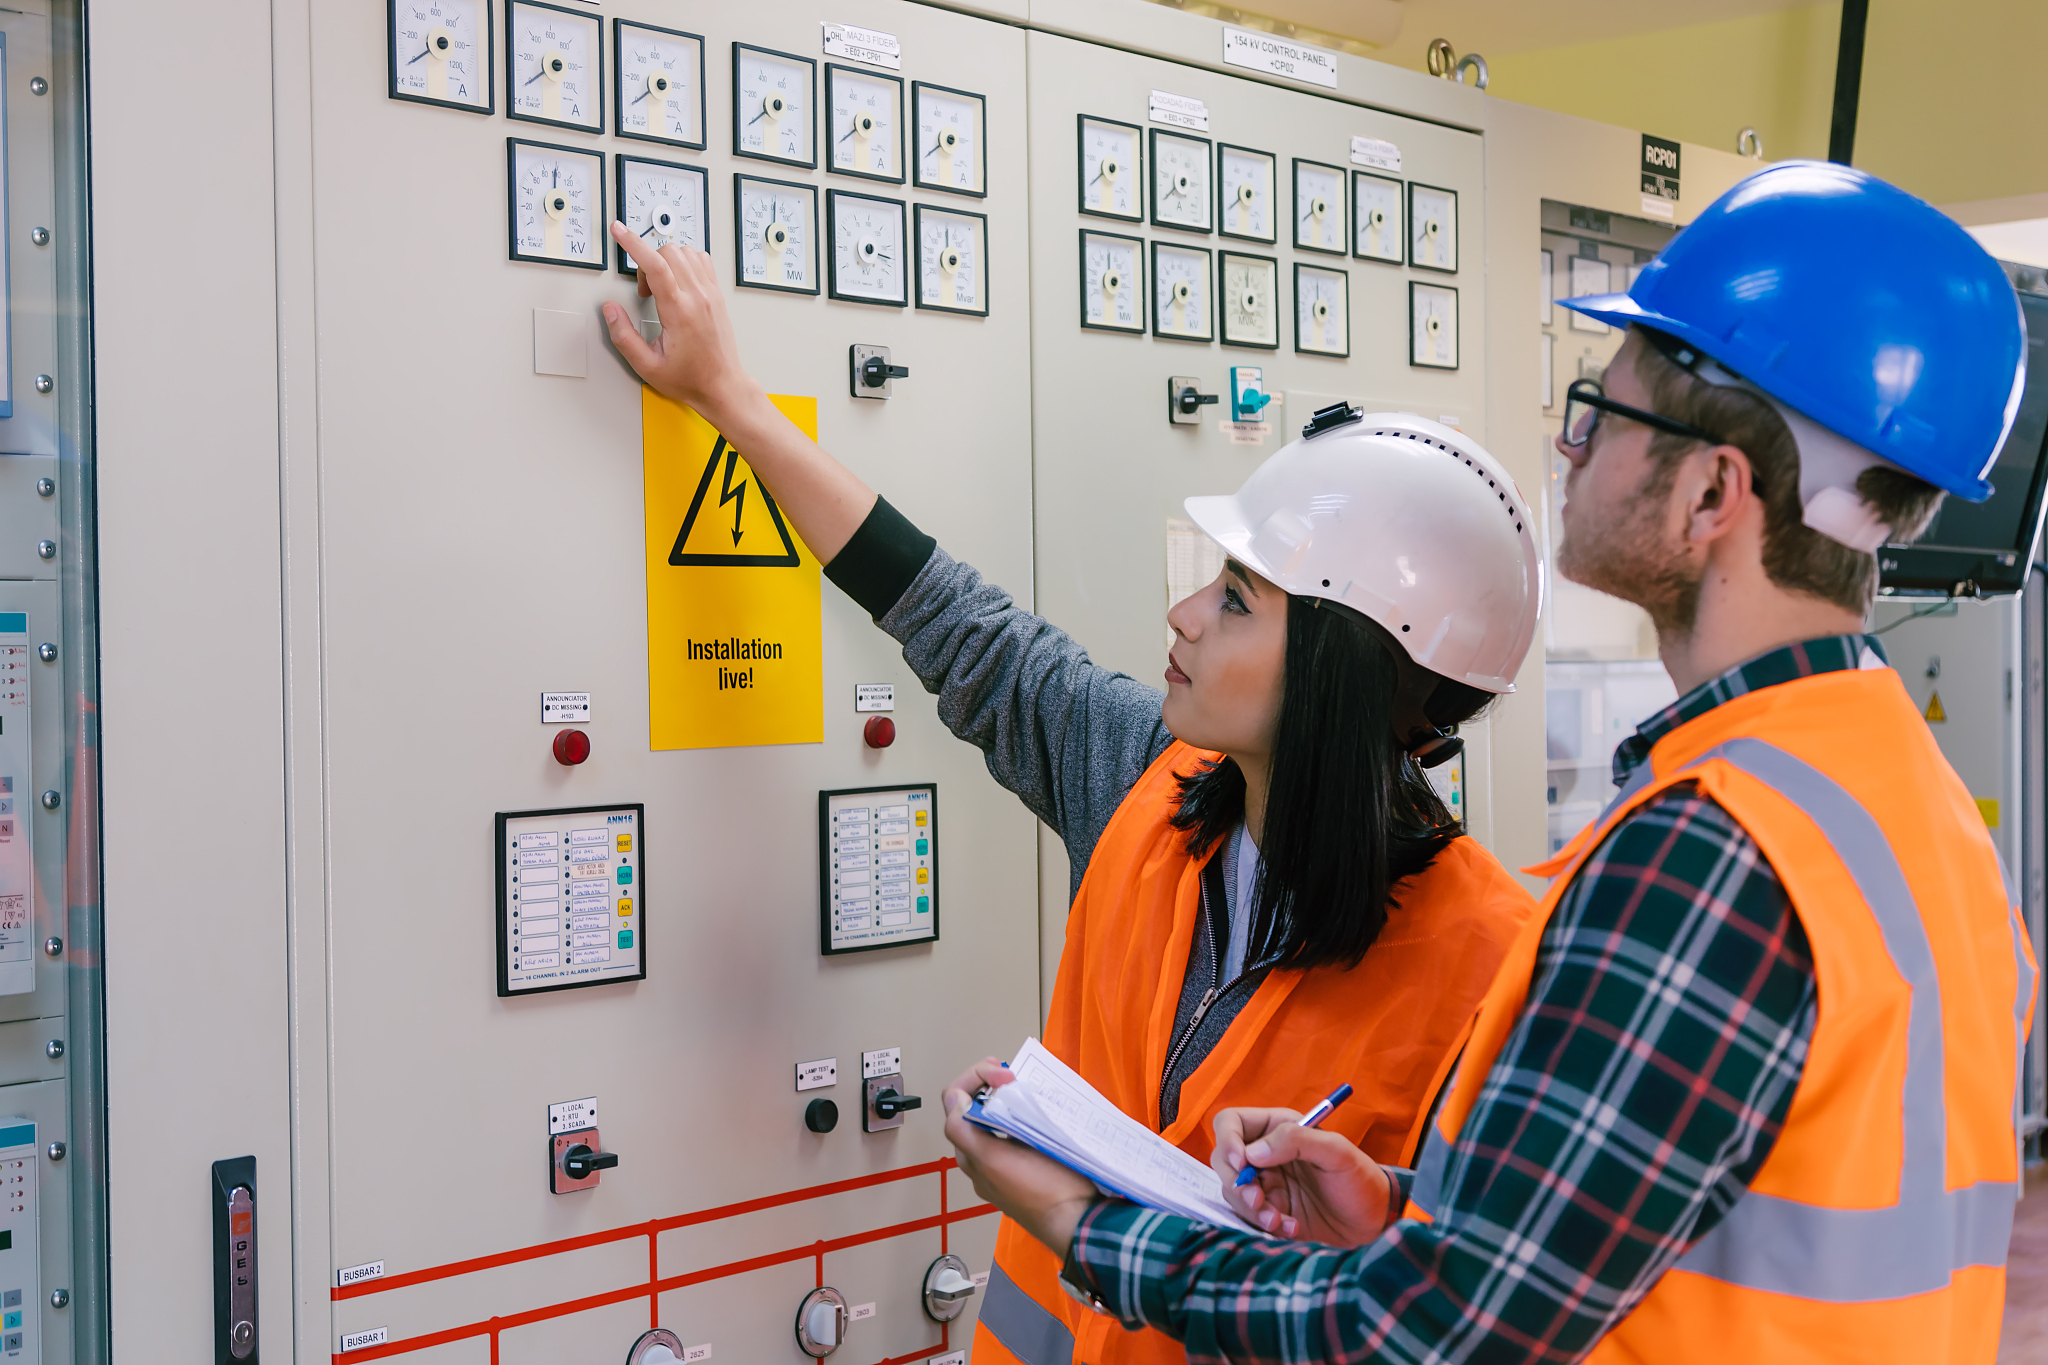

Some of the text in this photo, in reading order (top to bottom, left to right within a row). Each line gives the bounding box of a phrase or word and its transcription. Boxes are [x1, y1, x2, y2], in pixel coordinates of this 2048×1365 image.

[415, 12, 426, 21] 400
[431, 8, 441, 17] 600
[446, 19, 456, 28] 800
[407, 31, 418, 39] 200
[531, 35, 541, 43] 400
[546, 31, 555, 39] 600
[831, 31, 843, 41] OHL
[866, 35, 871, 43] 3
[560, 42, 569, 50] 800
[1234, 35, 1328, 67] 154 kV CONTROL PANEL
[524, 53, 534, 61] 200
[638, 55, 647, 64] 400
[651, 52, 660, 60] 600
[867, 52, 881, 61] CP01
[450, 61, 462, 69] 1200
[664, 62, 673, 70] 800
[1270, 60, 1294, 73] +CP02
[631, 73, 640, 81] 200
[458, 84, 467, 97] A
[563, 82, 575, 90] 1200
[748, 90, 757, 98] 200
[667, 100, 678, 109] 1200
[572, 104, 580, 116] A
[675, 122, 683, 134] A
[788, 142, 795, 154] A
[1645, 144, 1677, 170] RCP01
[877, 158, 885, 169] A
[542, 170, 548, 178] 80
[960, 173, 967, 184] A
[533, 177, 540, 185] 60
[564, 179, 573, 187] 120
[1120, 199, 1126, 209] A
[1176, 201, 1182, 211] A
[571, 206, 581, 214] 160
[530, 216, 534, 224] 0
[1255, 222, 1260, 232] A
[571, 241, 585, 254] kV
[787, 270, 803, 281] MW
[957, 293, 974, 303] Mvar
[687, 637, 782, 660] Installation
[719, 667, 753, 690] live!
[607, 815, 633, 824] ANN16
[344, 1265, 381, 1281] BUSBAR 2
[347, 1331, 384, 1347] BUSBAR 1
[690, 1350, 705, 1359] 2825
